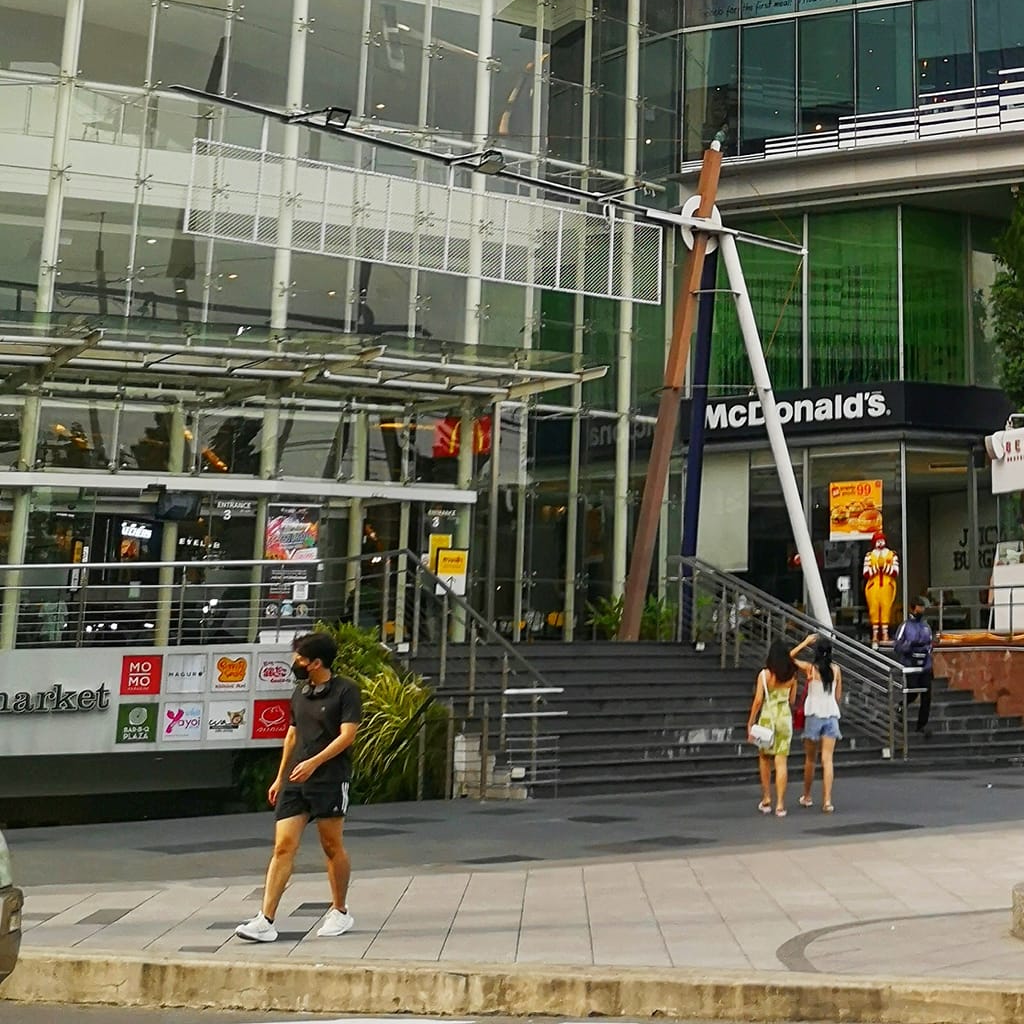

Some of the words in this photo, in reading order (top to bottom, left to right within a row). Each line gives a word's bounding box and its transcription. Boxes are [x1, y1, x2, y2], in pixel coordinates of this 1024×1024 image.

[704, 392, 887, 430] McDonald's
[217, 500, 252, 509] ENTRANCE
[223, 509, 232, 521] 3
[129, 662, 152, 673] MO
[128, 676, 151, 687] MO
[166, 708, 201, 734] Yayoi
